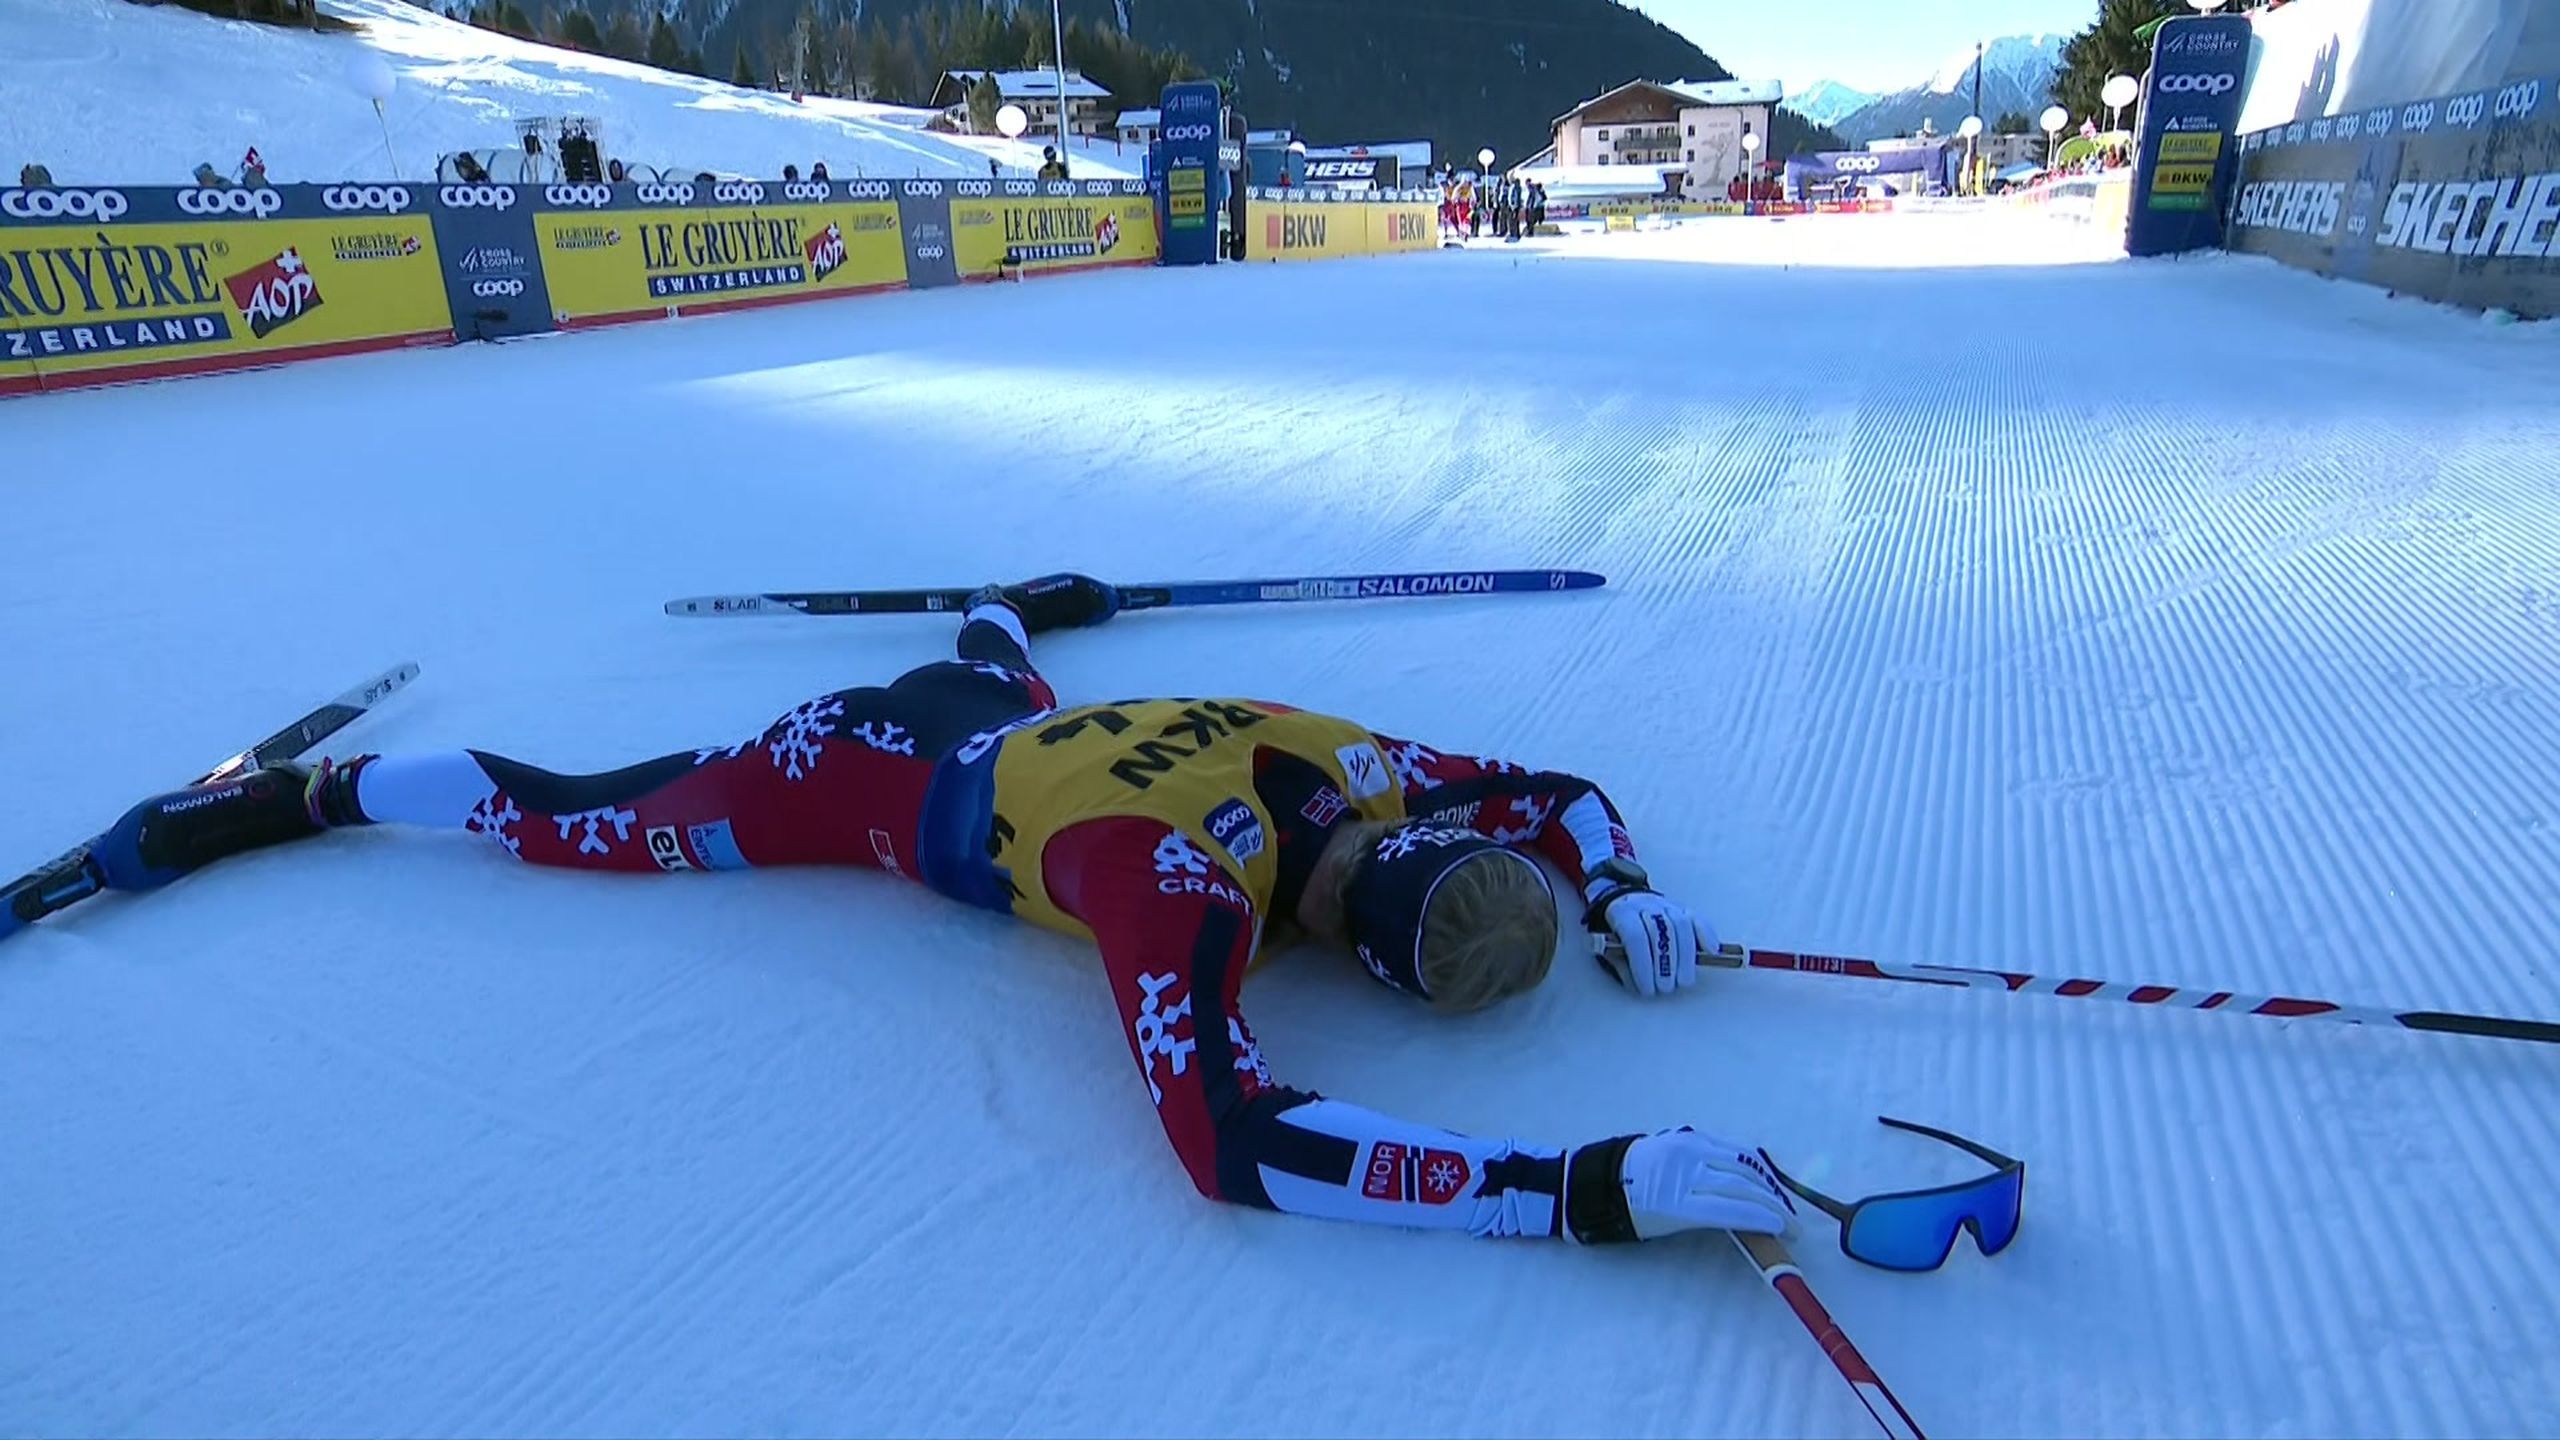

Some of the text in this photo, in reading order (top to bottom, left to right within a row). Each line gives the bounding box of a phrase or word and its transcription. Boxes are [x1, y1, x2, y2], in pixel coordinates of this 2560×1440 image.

[2159, 73, 2235, 95] coop
[2366, 108, 2393, 138] coop
[2402, 101, 2434, 134] coop
[2446, 93, 2484, 130] coop
[2495, 80, 2539, 119] coop
[1166, 124, 1211, 141] coop
[1304, 161, 1376, 177] HERS
[1835, 156, 1880, 173] coop
[1, 189, 128, 222] coop
[177, 188, 281, 219] coop
[322, 186, 410, 213] coop
[440, 186, 516, 210] coop
[544, 184, 612, 208] coop
[637, 183, 695, 205] coop
[713, 183, 765, 204] coop
[785, 182, 830, 203] coop
[849, 181, 890, 200] coop
[904, 180, 943, 198] coop
[957, 181, 992, 198] coop
[1005, 181, 1036, 197] coop
[1047, 181, 1076, 198] coop
[1087, 180, 1113, 196] coop
[2236, 173, 2560, 257] SKECHERS SKECHE
[1004, 209, 1024, 242] LE
[1028, 202, 1094, 241] GRUYÈRE
[1284, 213, 1426, 249] BKW BKW
[639, 210, 803, 270] LE GRUYÈRE
[917, 244, 944, 261] coop
[473, 280, 523, 297] coop
[656, 266, 800, 294] SWITZERLAND
[246, 270, 314, 326] AOP
[1359, 573, 1494, 597] SALOMON
[1213, 804, 1251, 838] coop
[1158, 877, 1250, 916] CRAFT
[1367, 1143, 1396, 1194] NOR
